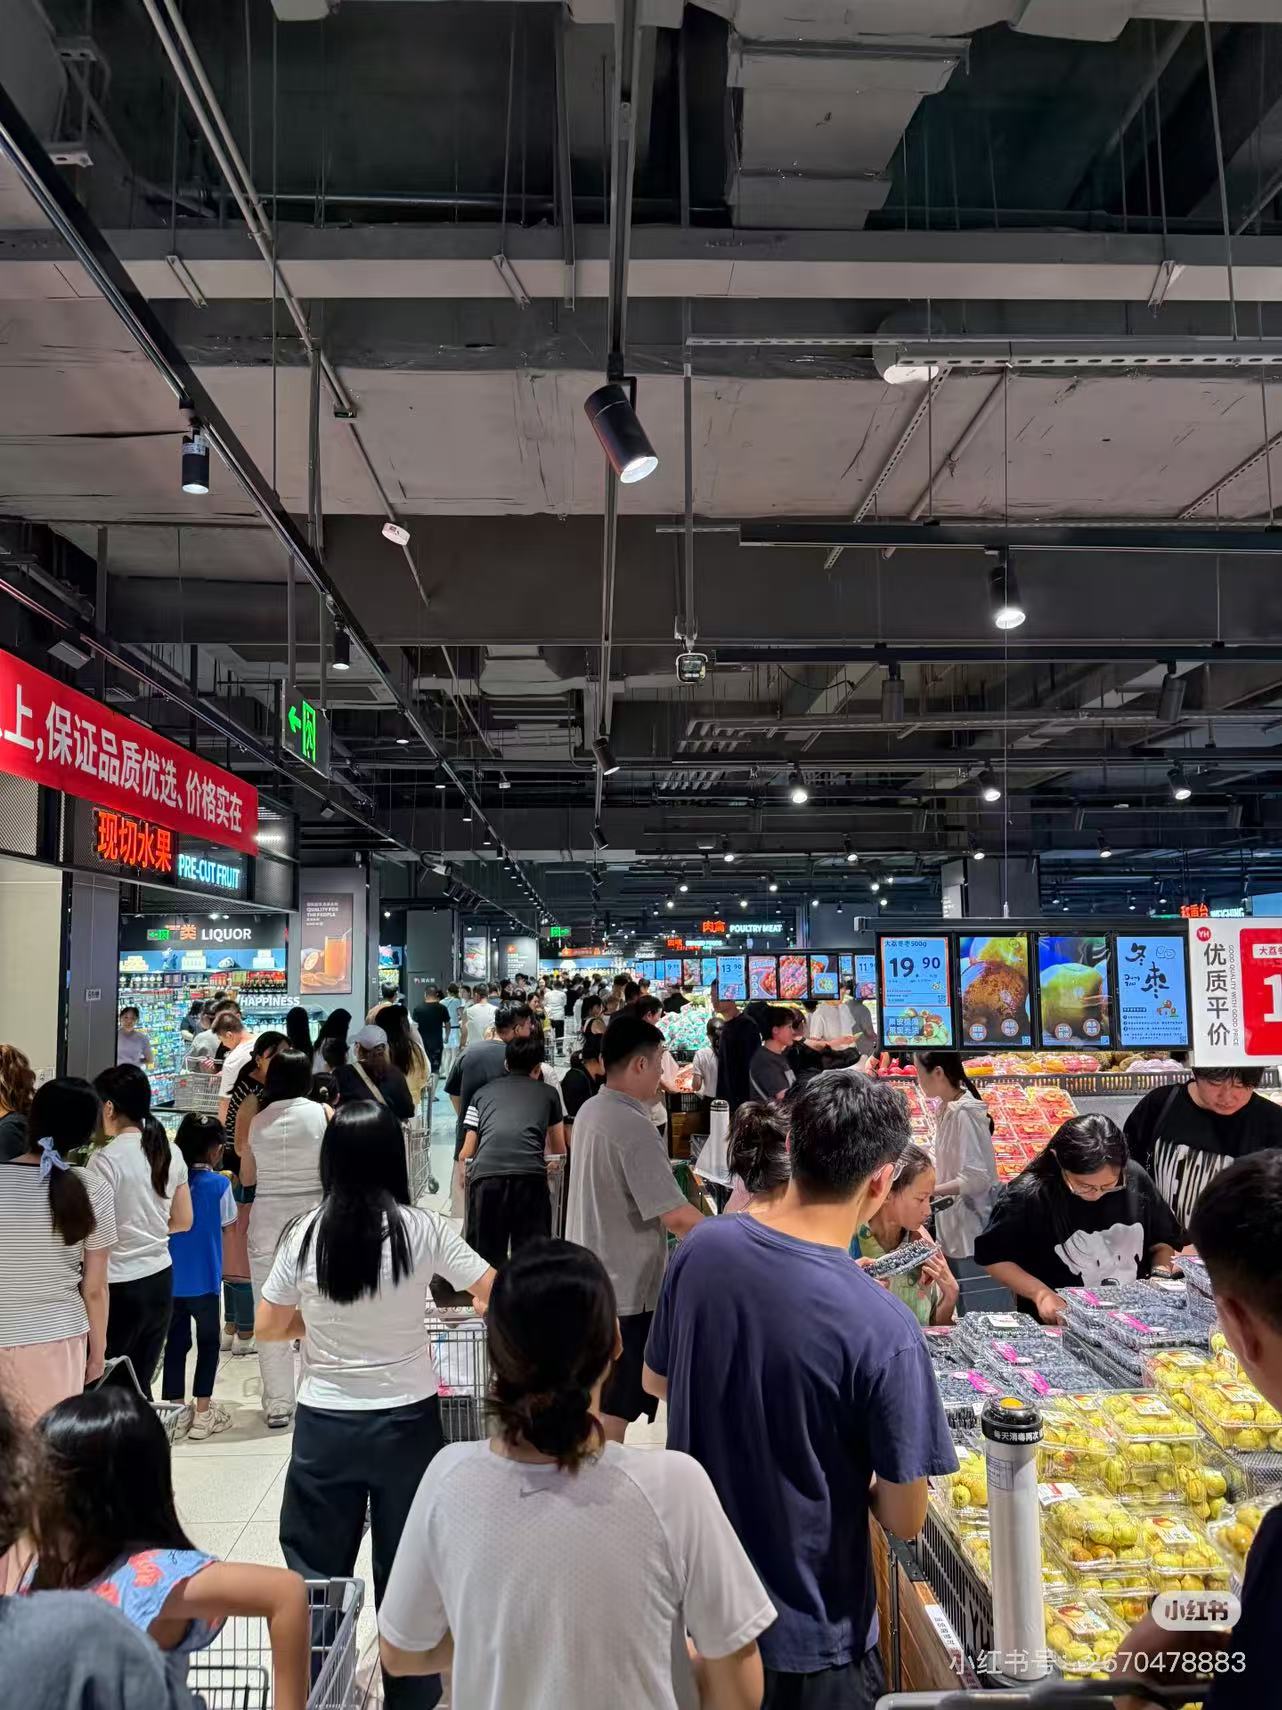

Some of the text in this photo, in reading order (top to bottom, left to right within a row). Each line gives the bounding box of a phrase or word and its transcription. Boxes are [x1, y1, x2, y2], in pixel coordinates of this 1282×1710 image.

[0, 684, 243, 833] 上,保证品质优选、价格实在
[97, 811, 172, 873] 现切水果
[178, 853, 240, 889] PRE-CUT FRUIT
[201, 928, 253, 943] LIQUOR
[729, 923, 783, 933] POULTRY MEAT
[721, 964, 731, 973] 13
[1229, 964, 1237, 990] QUALITY
[239, 995, 301, 1007] HAPPINESS
[1203, 943, 1231, 1047] 优质平价
[1231, 1008, 1239, 1028] GOOD
[1232, 1028, 1240, 1046] PRICE
